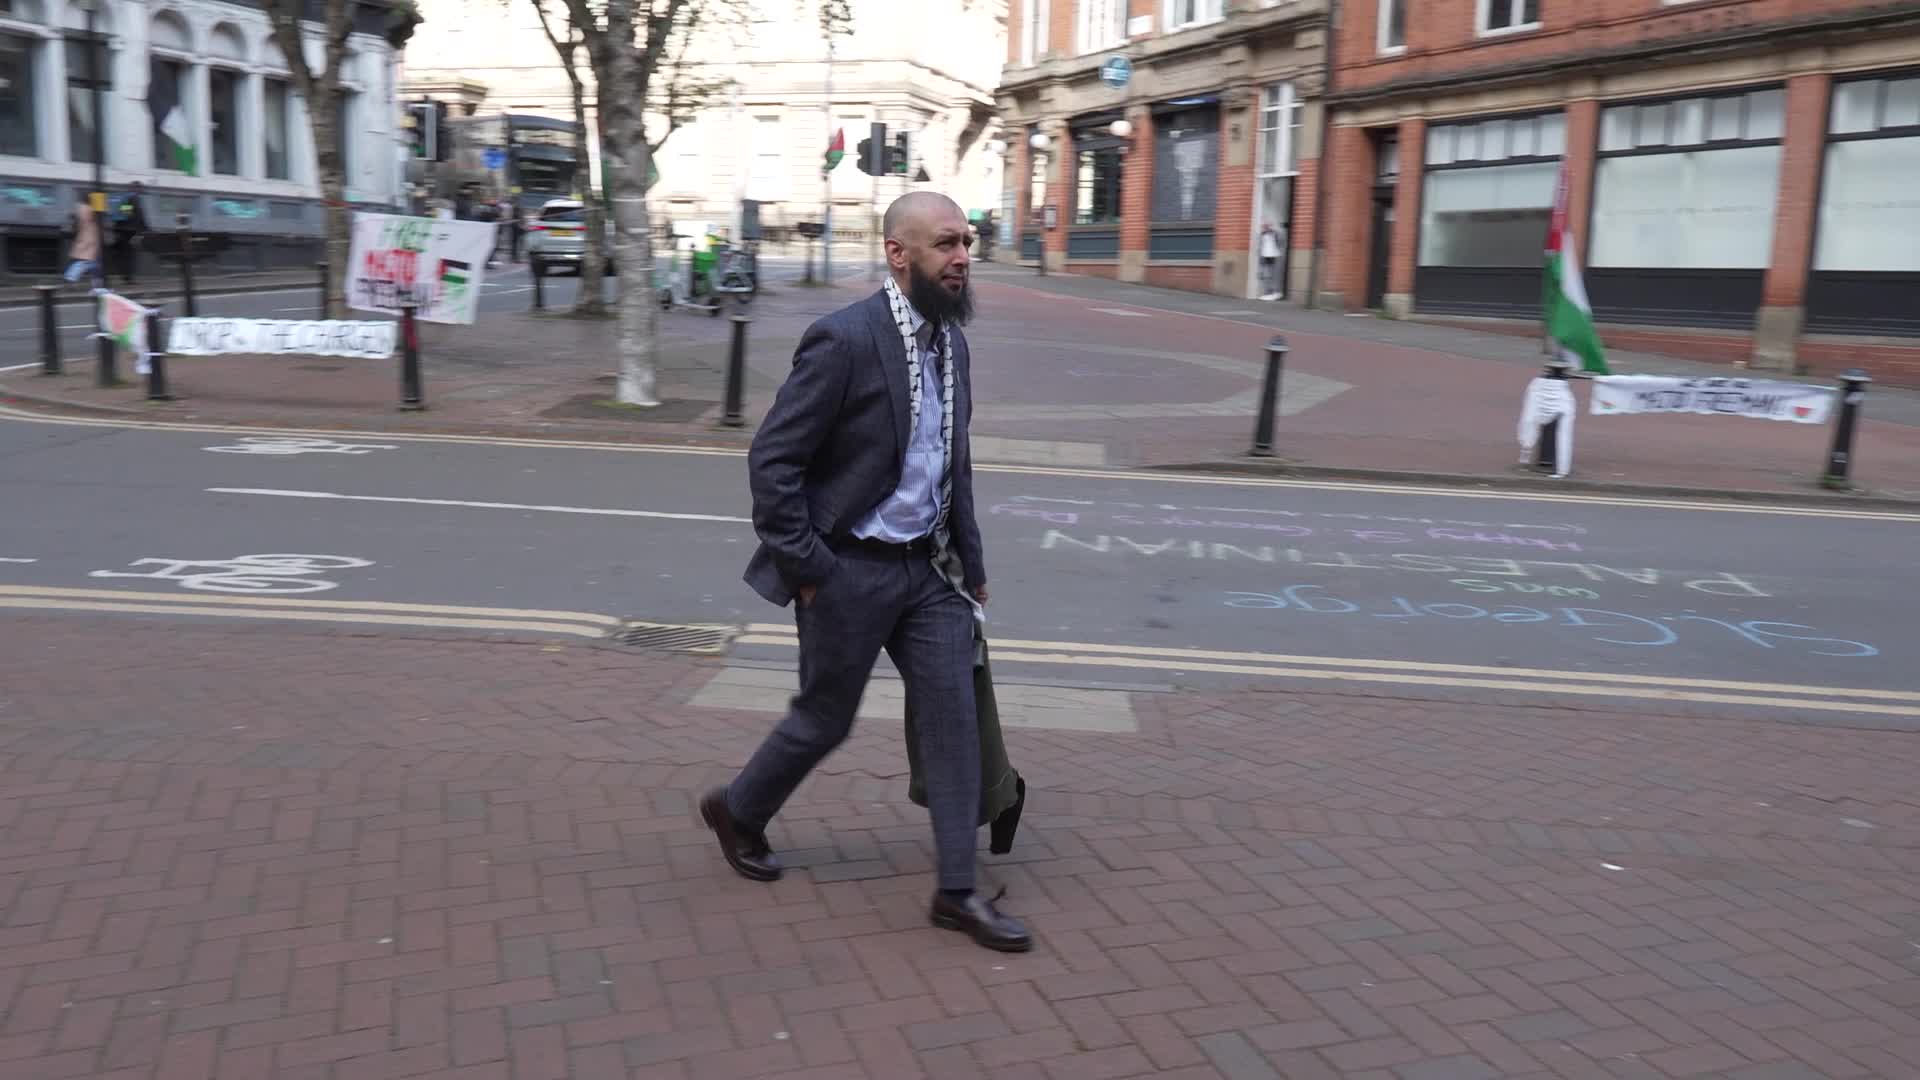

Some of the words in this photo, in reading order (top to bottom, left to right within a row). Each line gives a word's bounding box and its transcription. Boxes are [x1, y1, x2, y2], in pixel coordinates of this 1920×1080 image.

[1040, 529, 1774, 598] PALESTINIAN
[1449, 578, 1600, 601] was
[1224, 584, 1678, 646] George
